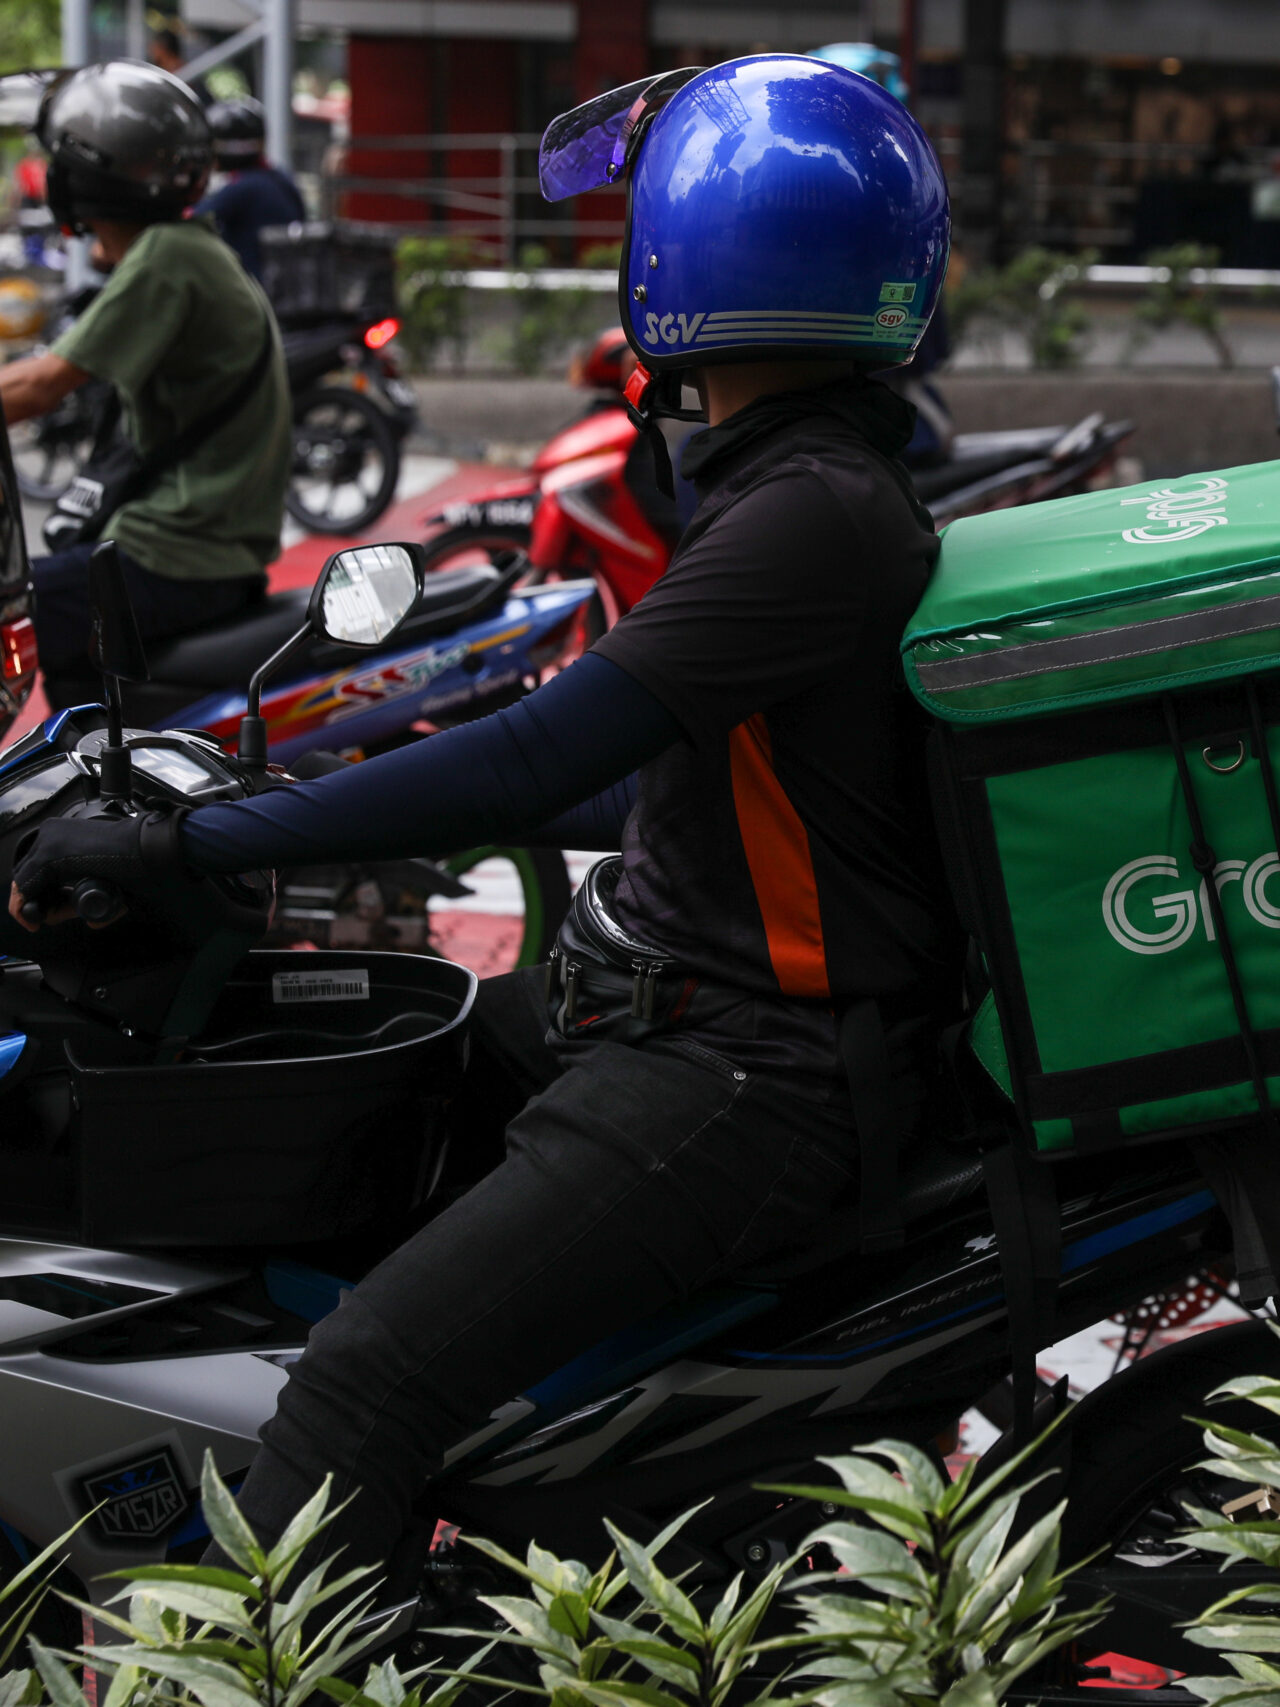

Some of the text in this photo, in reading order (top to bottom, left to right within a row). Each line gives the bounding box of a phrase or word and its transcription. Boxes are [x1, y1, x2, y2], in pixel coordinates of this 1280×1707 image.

[643, 311, 707, 345] SGV
[879, 313, 904, 326] sgv
[1119, 477, 1229, 544] Grab
[836, 1273, 1003, 1342] FUEL INJECTIO
